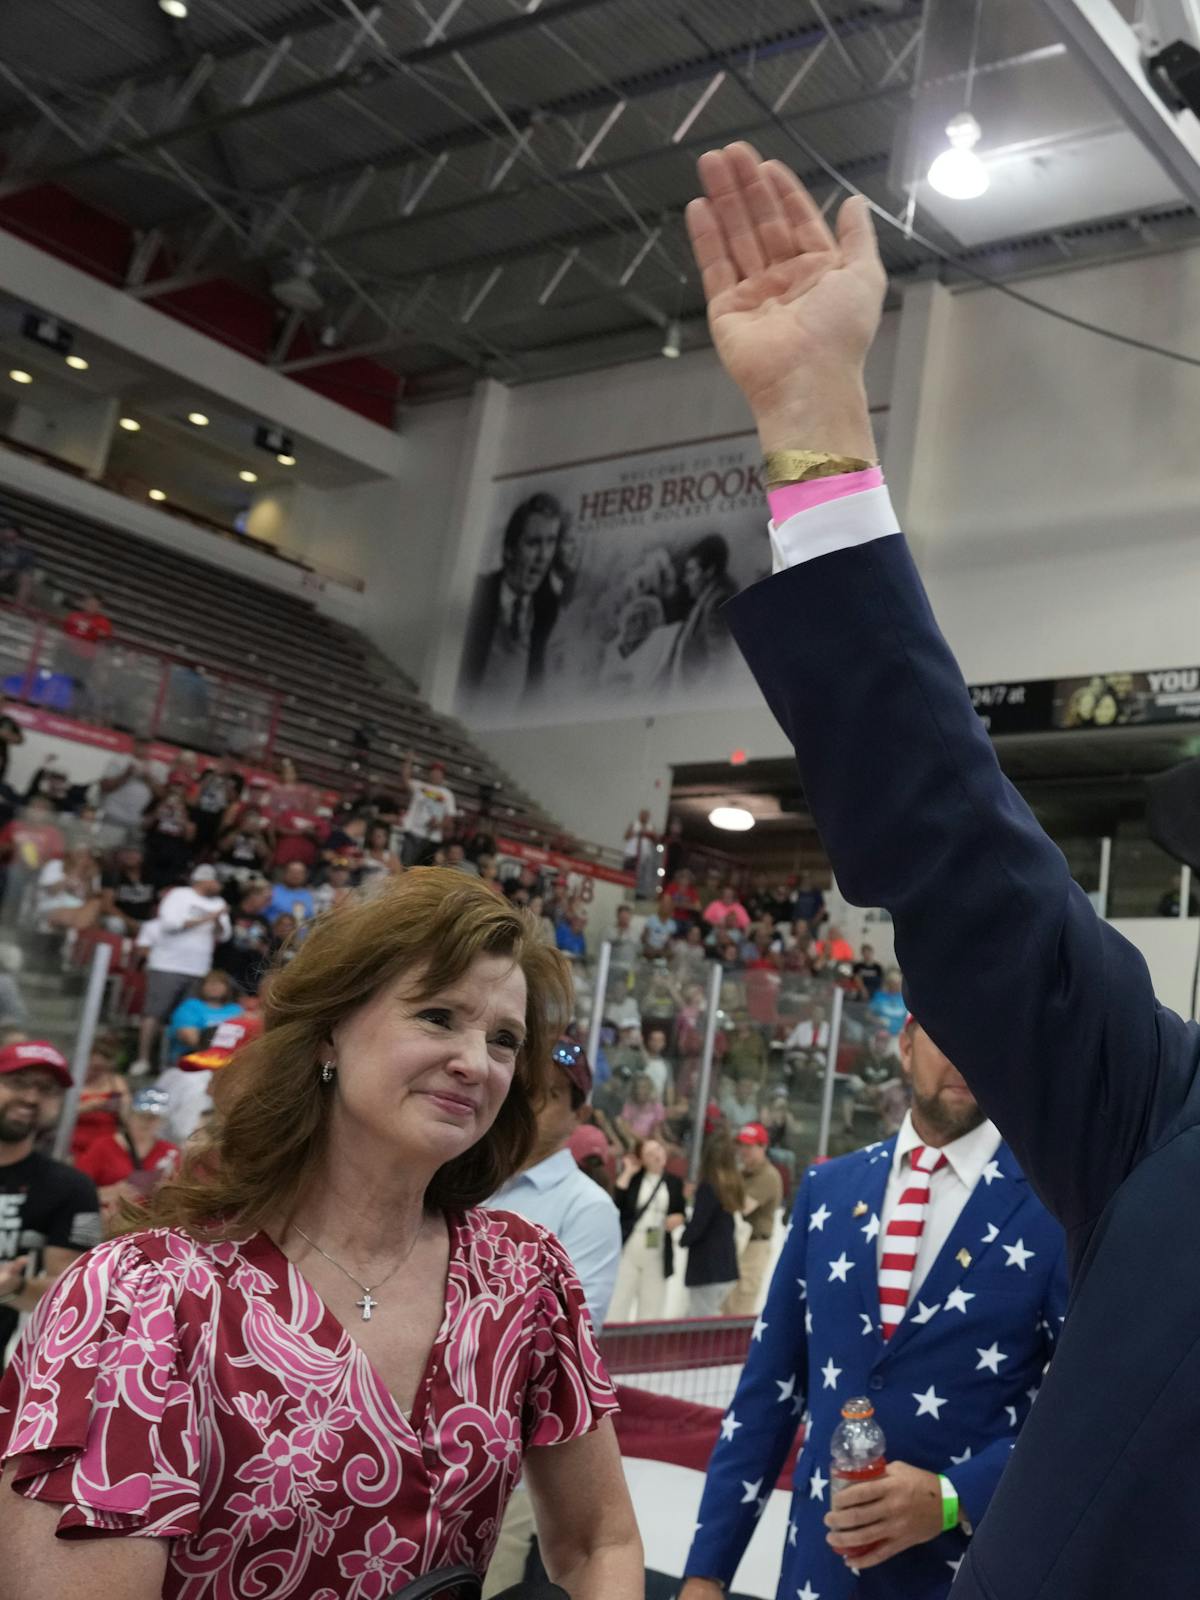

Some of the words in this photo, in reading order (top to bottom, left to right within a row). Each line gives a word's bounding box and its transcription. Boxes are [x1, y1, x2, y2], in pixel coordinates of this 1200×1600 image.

[578, 482, 654, 522] HERB
[659, 465, 765, 509] BROOK
[1147, 669, 1199, 693] YOU
